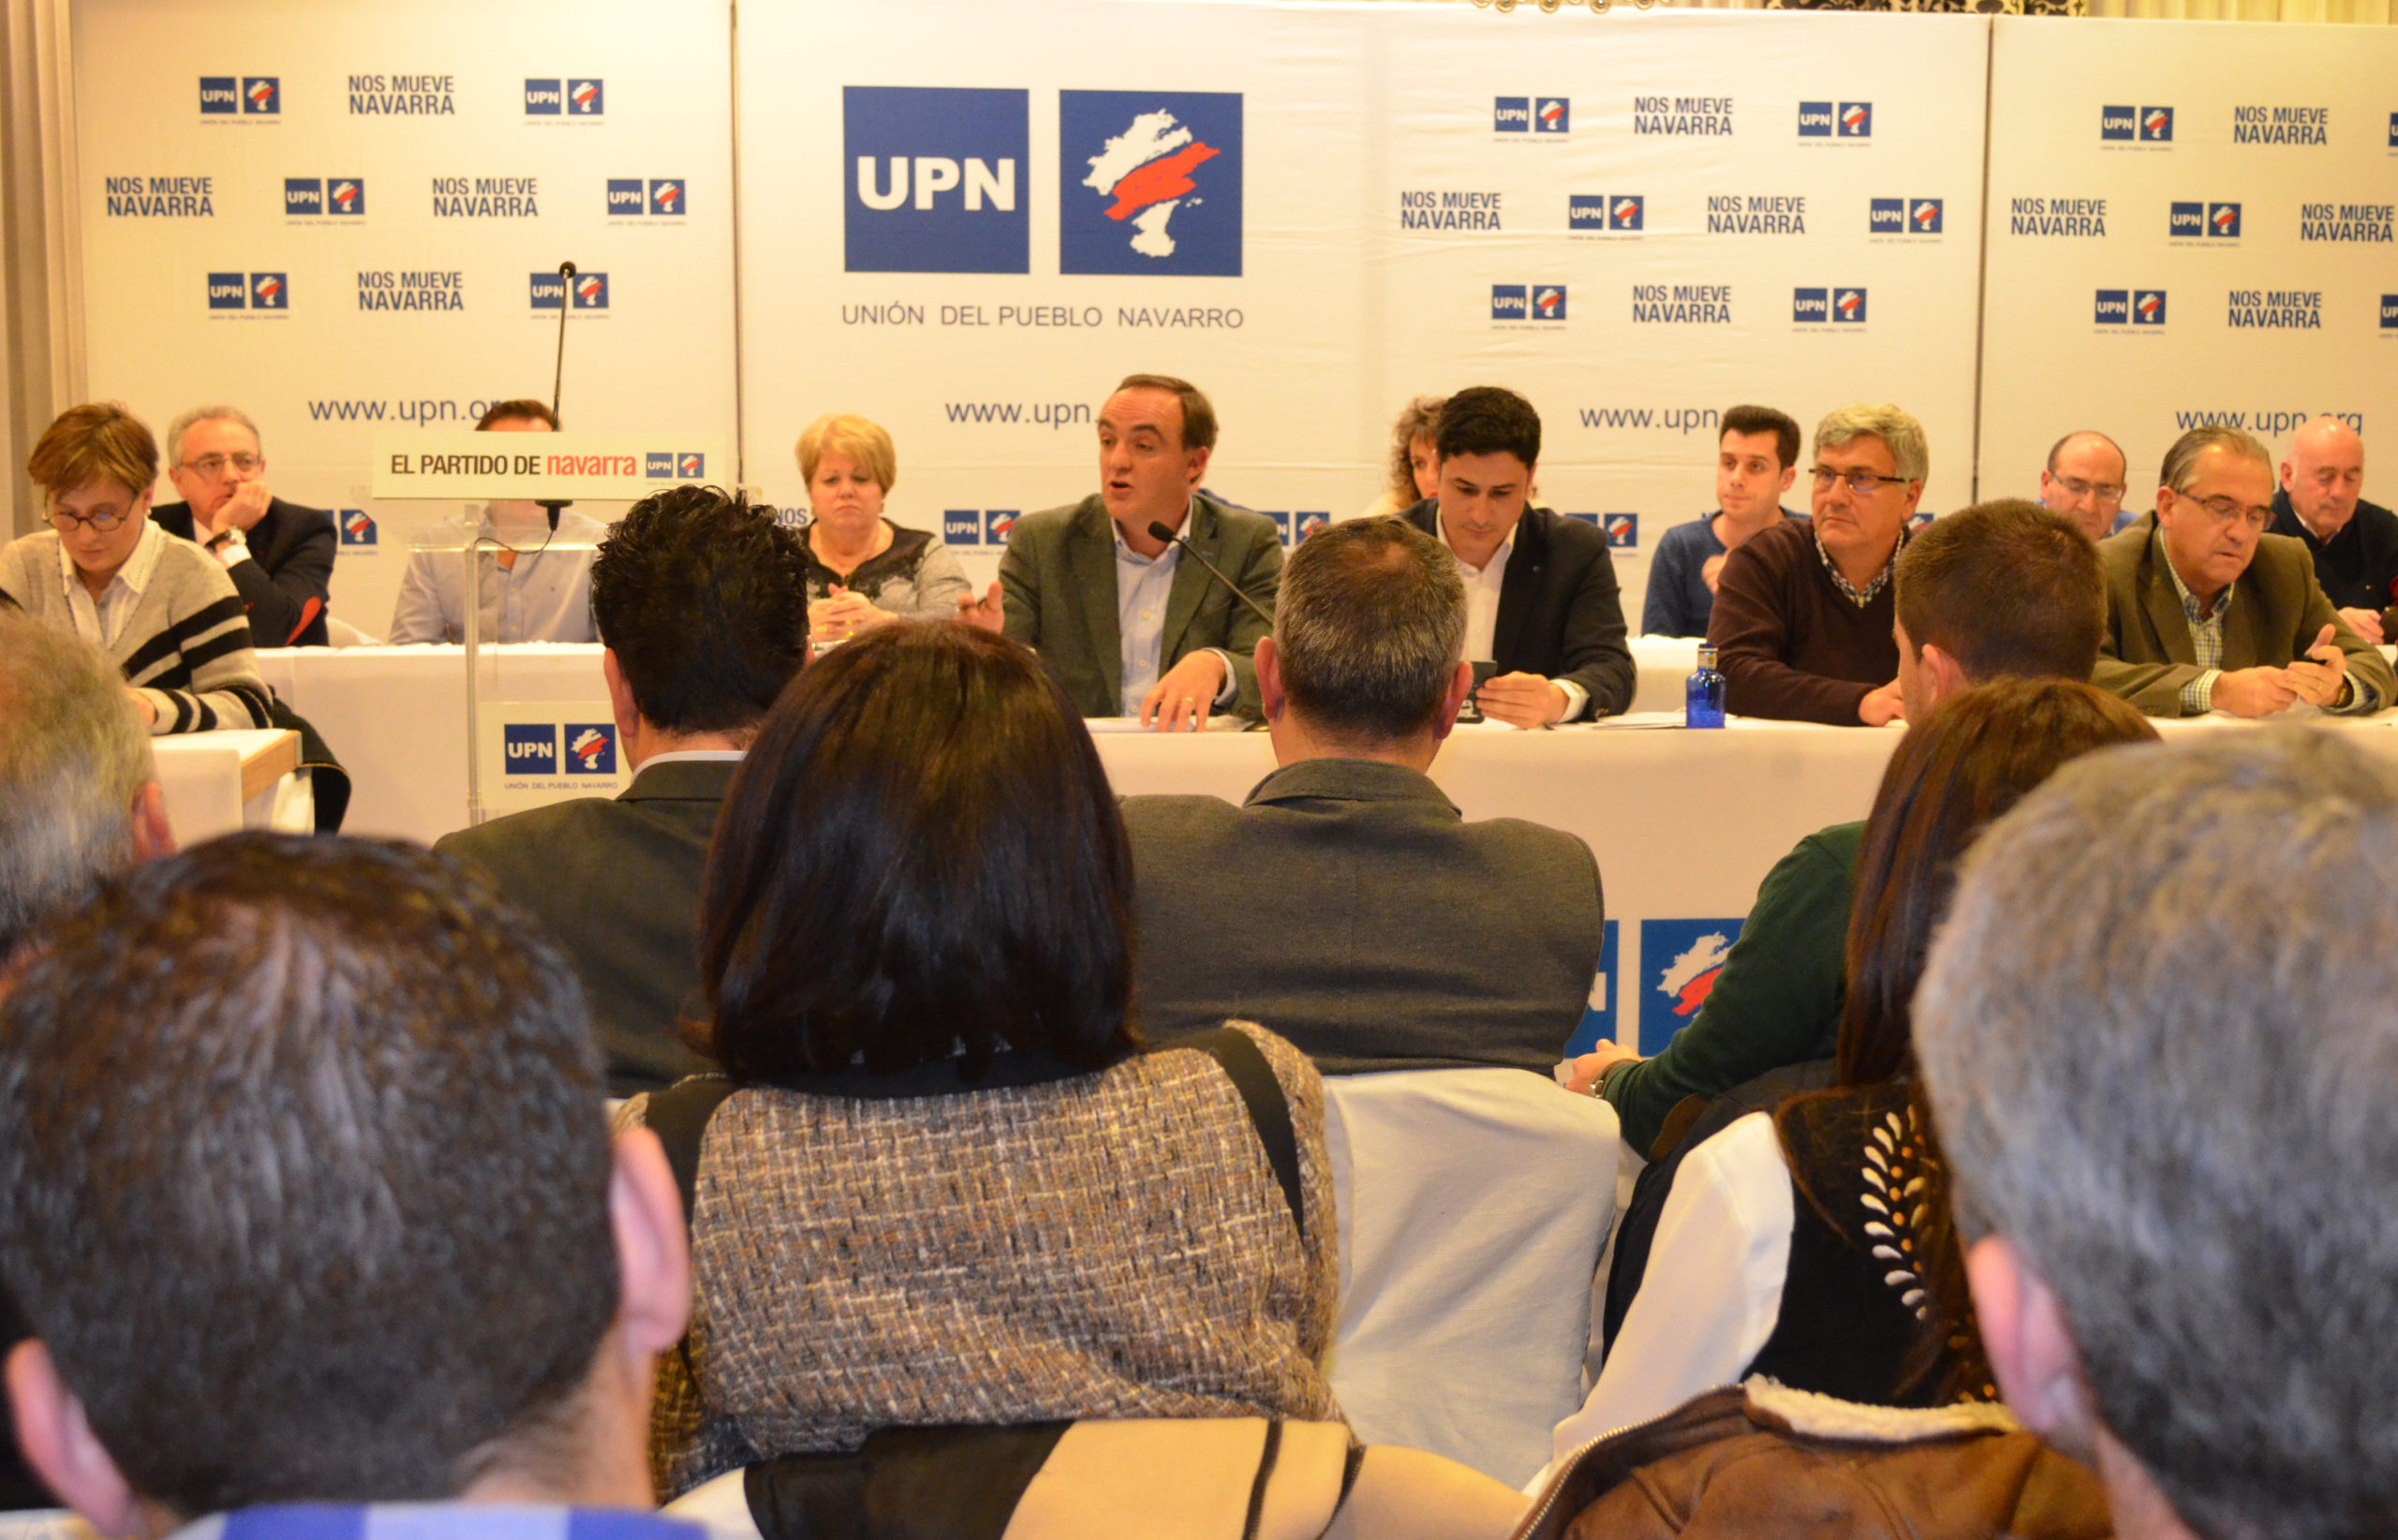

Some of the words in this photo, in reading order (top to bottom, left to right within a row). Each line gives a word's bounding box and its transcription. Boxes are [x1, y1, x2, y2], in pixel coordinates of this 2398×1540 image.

[348, 75, 385, 93] NOS
[392, 76, 453, 93] MUEVE
[201, 89, 236, 102] UPN
[349, 94, 454, 114] NAVARRA
[526, 91, 560, 104] UPN
[1635, 97, 1668, 113] NOS
[1676, 97, 1732, 114] MUEVE
[1496, 109, 1528, 122] UPN
[1799, 113, 1831, 126] UPN
[2103, 117, 2134, 130] UPN
[2235, 107, 2267, 123] NOS
[2273, 108, 2328, 125] MUEVE
[1635, 115, 1732, 135] NAVARRA
[2234, 124, 2327, 145] NAVARRA
[106, 177, 143, 195] NOS
[150, 177, 212, 195] MUEVE
[433, 178, 468, 195] NOS
[476, 178, 537, 195] MUEVE
[857, 155, 1015, 211] UPN
[287, 190, 320, 204] UPN
[609, 191, 642, 204] UPN
[1401, 192, 1436, 208] NOS
[1443, 192, 1501, 209] MUEVE
[1709, 196, 1741, 213] NOS
[1749, 197, 1804, 213] MUEVE
[107, 196, 214, 216] NAVARRA
[434, 197, 538, 216] NAVARRA
[1570, 207, 1603, 219] UPN
[2012, 199, 2044, 215] NOS
[2050, 200, 2106, 215] MUEVE
[2302, 204, 2333, 220] NOS
[2340, 205, 2394, 222] MUEVE
[1401, 210, 1501, 230] NAVARRA
[1708, 215, 1805, 234] NAVARRA
[1871, 210, 1902, 222] UPN
[2171, 214, 2201, 226] UPN
[2011, 215, 2106, 236] NAVARRA
[2302, 221, 2393, 242] NAVARRA
[358, 272, 394, 289] NOS
[402, 272, 462, 289] MUEVE
[210, 285, 244, 298] UPN
[359, 290, 463, 310] NAVARRA
[531, 285, 565, 298] UPN
[1634, 286, 1667, 302] NOS
[1674, 286, 1730, 302] MUEVE
[2229, 291, 2261, 307] NOS
[2267, 291, 2321, 308] MUEVE
[1493, 297, 1526, 310] UPN
[1795, 299, 1826, 312] UPN
[2096, 301, 2126, 314] UPN
[2381, 306, 2398, 318] UP
[843, 301, 924, 325] UNIÓN
[941, 305, 989, 325] DEL
[999, 306, 1102, 327] PUEBLO
[1118, 308, 1243, 328] NAVARRO
[1634, 304, 1730, 322] NAVARRA
[2228, 309, 2320, 329] NAVARRA
[308, 399, 502, 427] www.upn.o
[945, 404, 1099, 430] www.upn.
[1579, 408, 1718, 435] www.upn
[392, 455, 415, 474] EL
[422, 455, 508, 475] PARTIDO
[514, 456, 540, 475] DE
[548, 456, 636, 476] navarra
[647, 461, 672, 470] UPN
[945, 522, 978, 534] UPN
[508, 742, 554, 759] UPN
